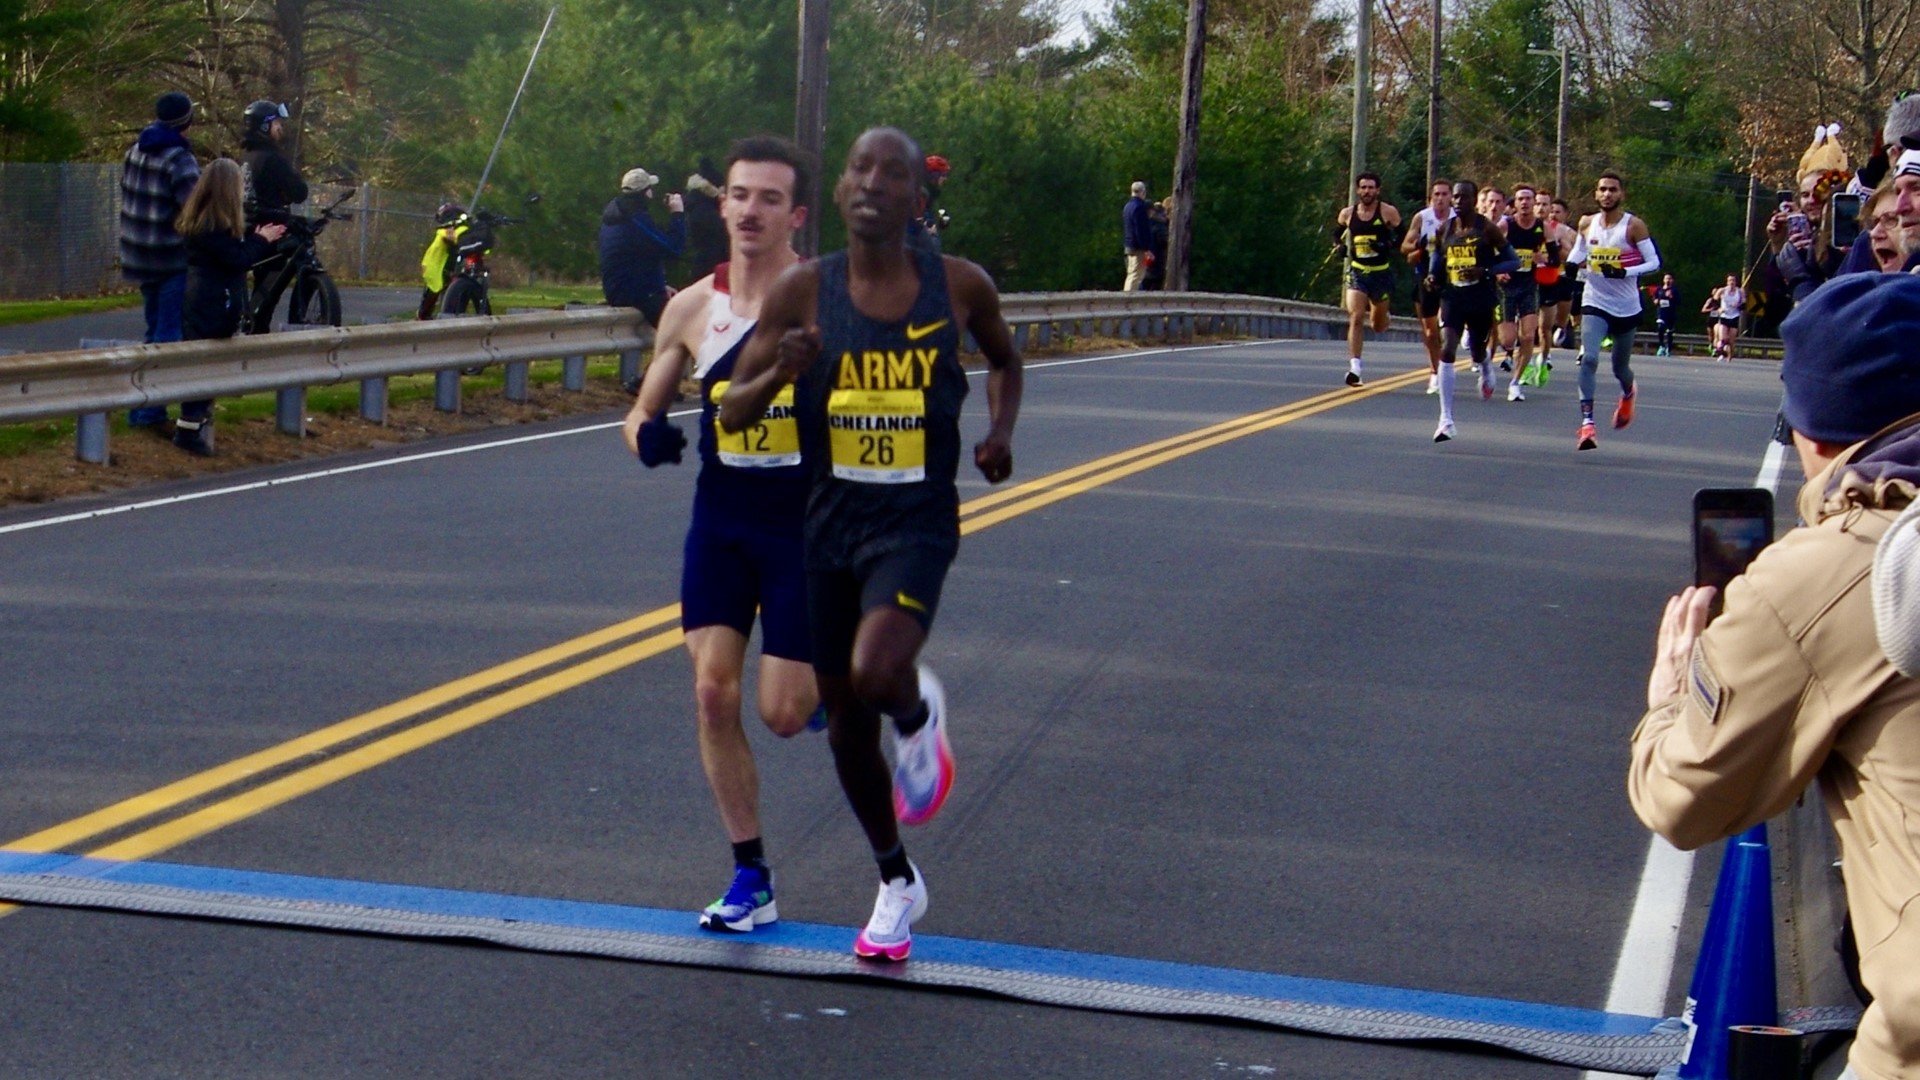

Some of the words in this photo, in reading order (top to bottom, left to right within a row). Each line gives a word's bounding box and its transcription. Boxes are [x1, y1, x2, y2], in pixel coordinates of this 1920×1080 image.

[1447, 245, 1477, 257] ARMY
[837, 348, 939, 390] ARMY
[742, 423, 771, 452] 12
[829, 415, 927, 431] CHELANGA
[858, 434, 895, 467] 26
